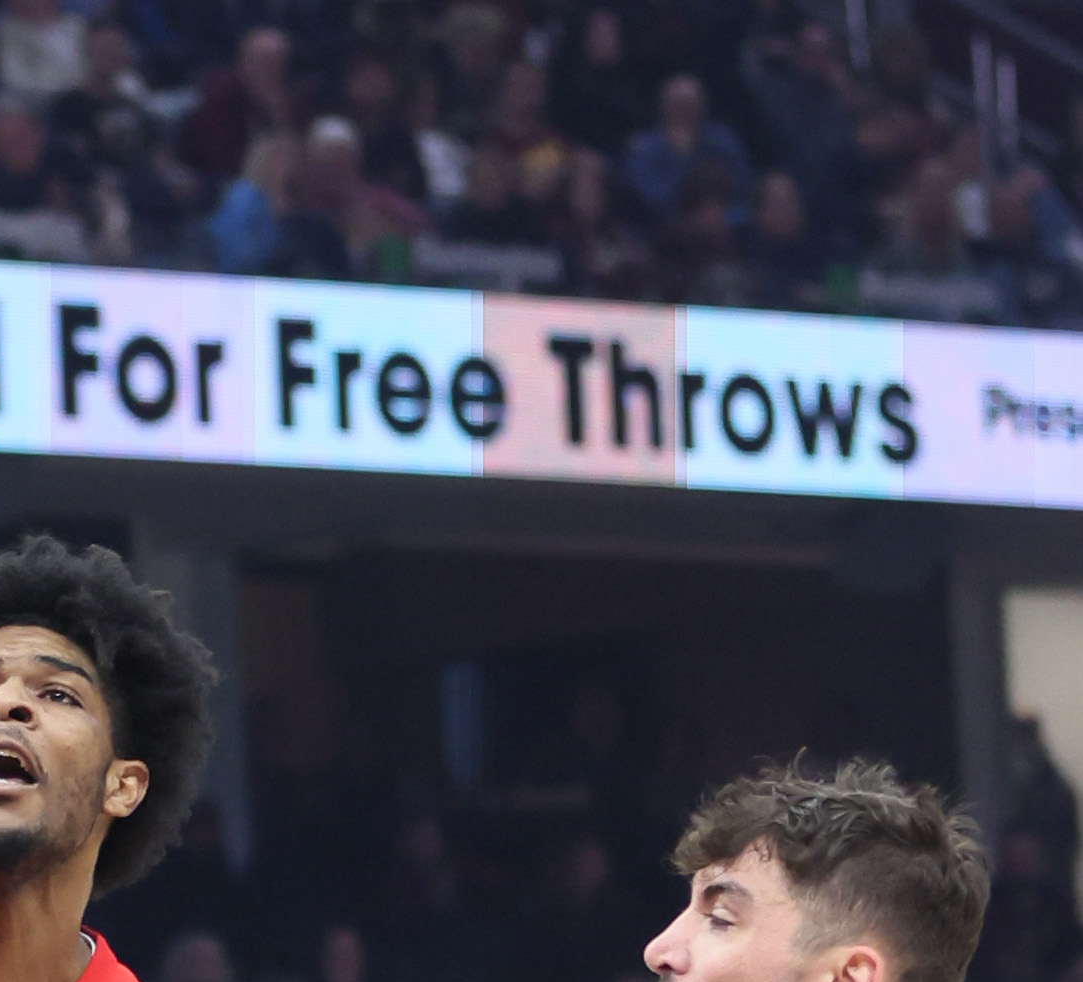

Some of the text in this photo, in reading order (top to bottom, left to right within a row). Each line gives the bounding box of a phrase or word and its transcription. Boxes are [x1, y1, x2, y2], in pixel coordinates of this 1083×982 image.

[59, 302, 224, 425] For
[277, 317, 506, 440] Free
[548, 334, 918, 464] Throws
